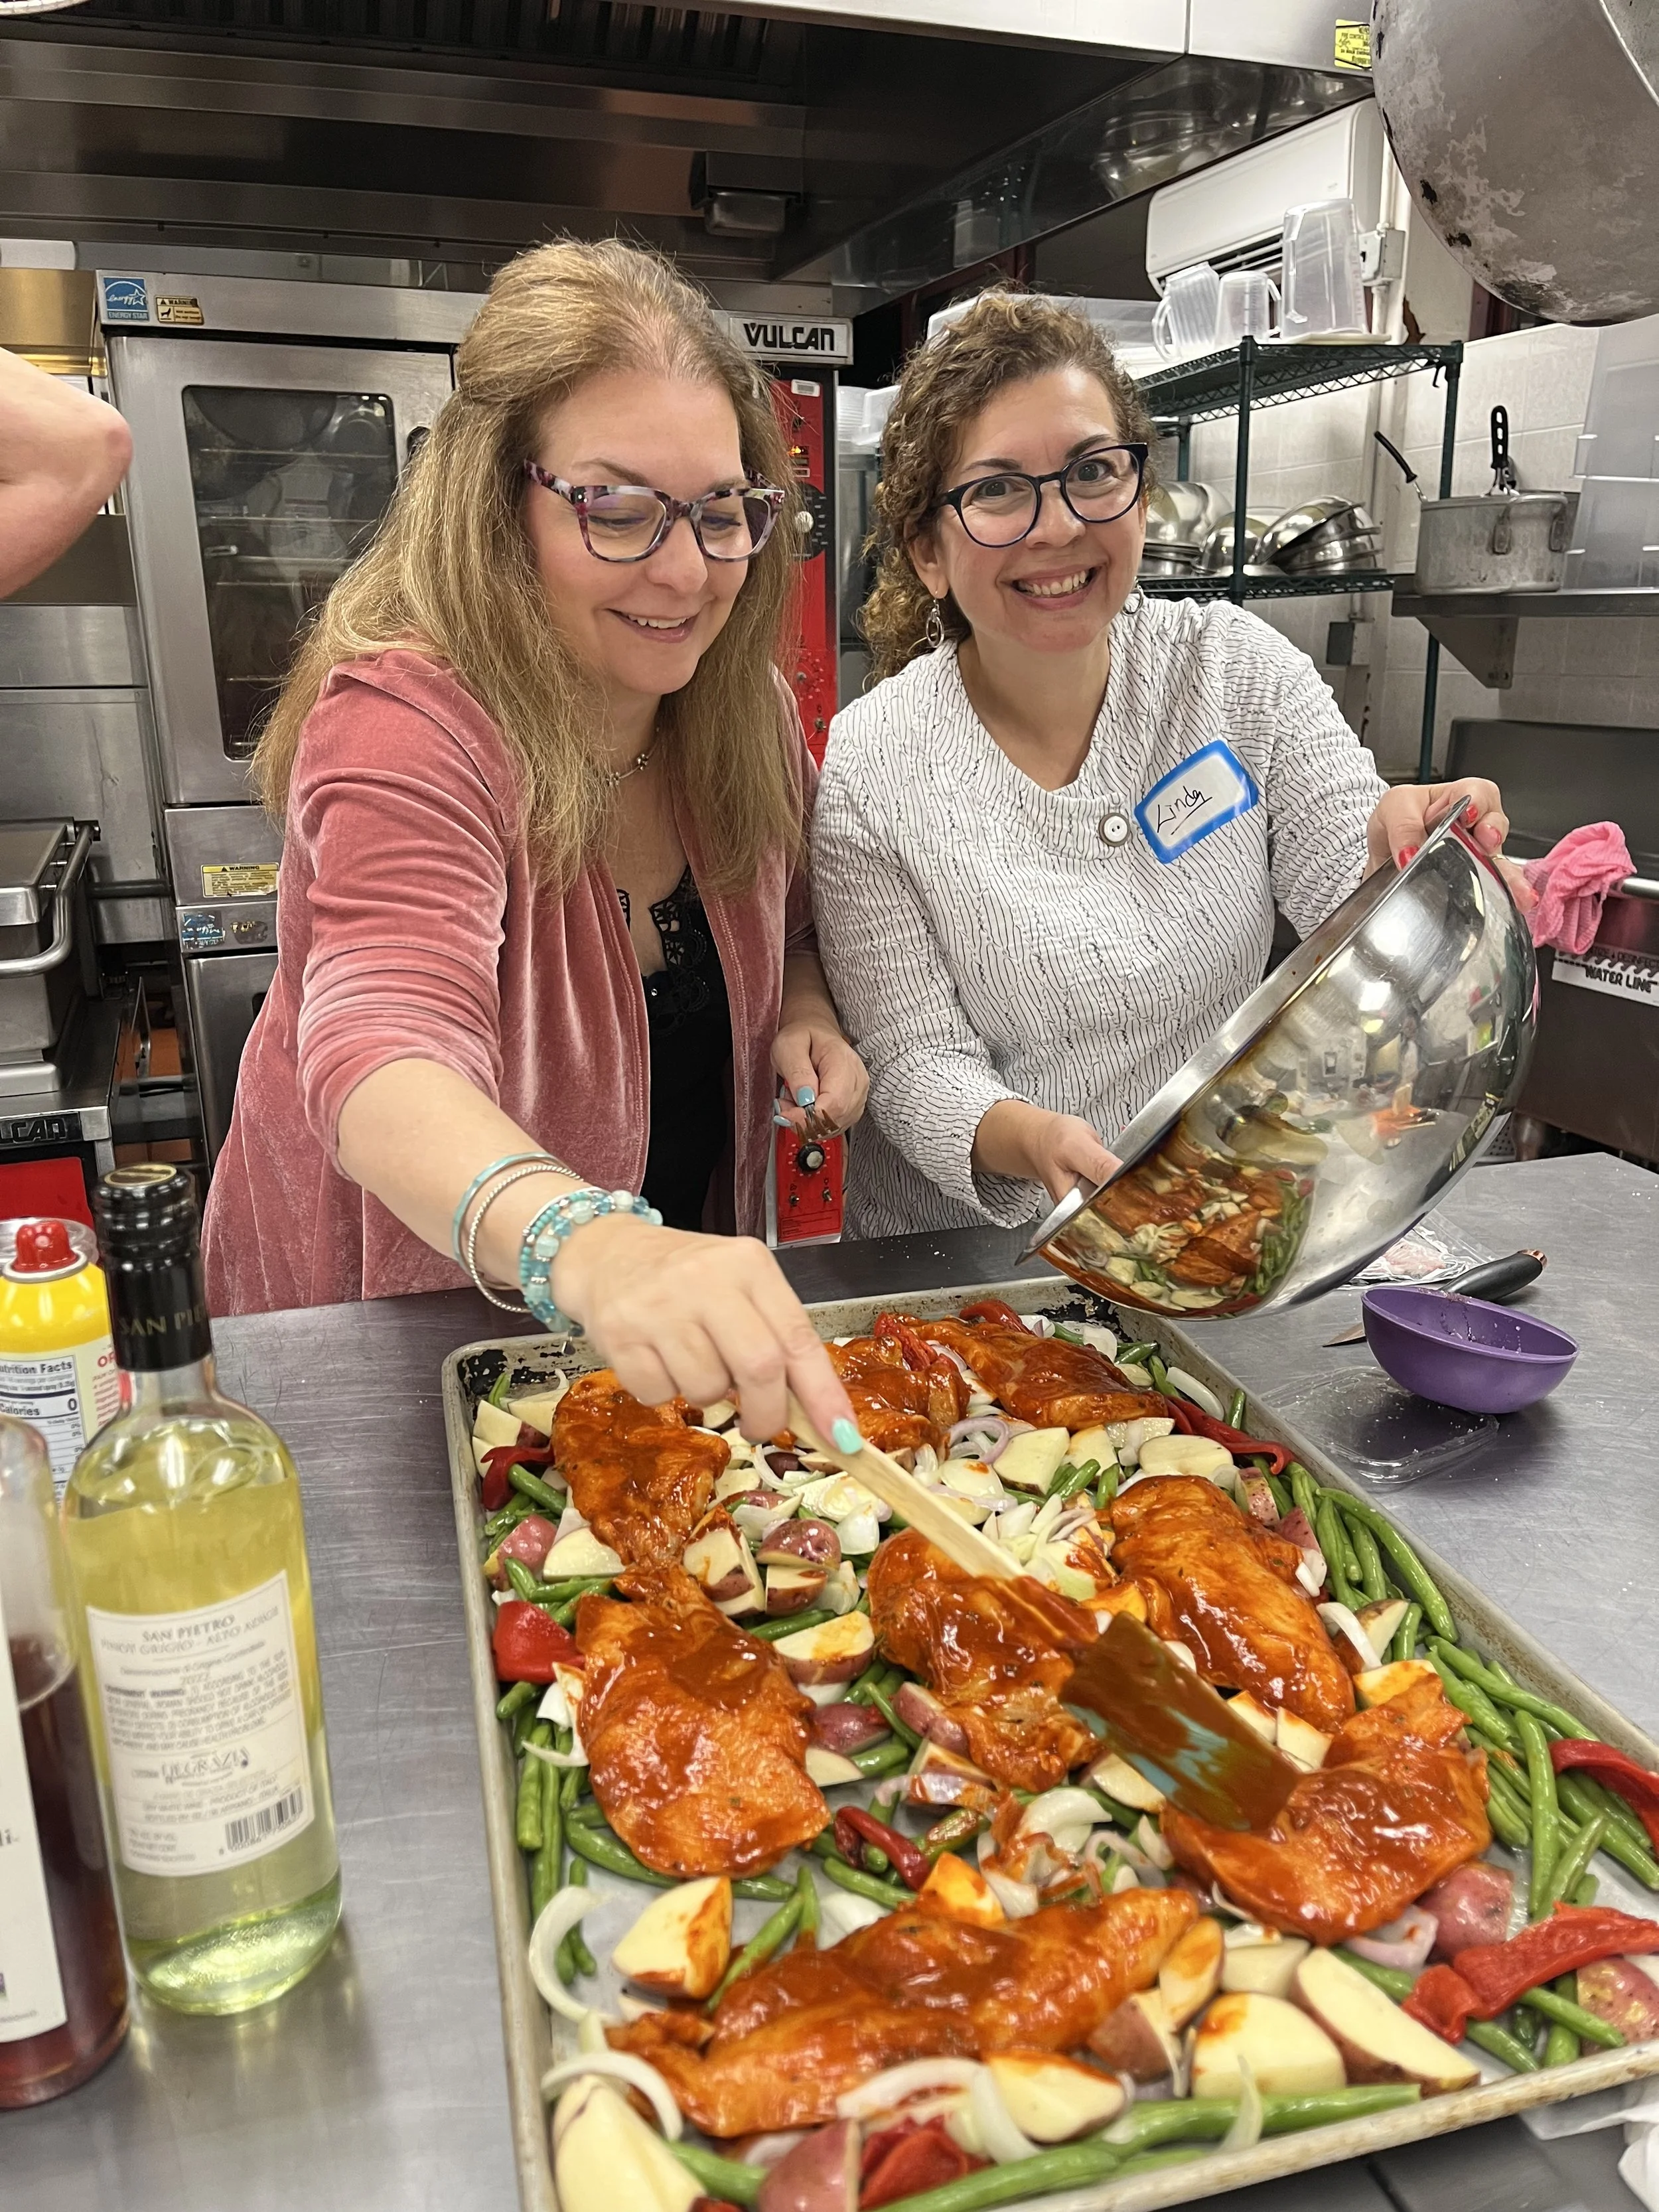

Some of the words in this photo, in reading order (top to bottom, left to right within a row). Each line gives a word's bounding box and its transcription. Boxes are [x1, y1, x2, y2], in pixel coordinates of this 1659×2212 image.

[743, 323, 835, 352] VULCAN
[1585, 965, 1623, 987] WATER
[1625, 974, 1652, 994] LINE
[40, 1361, 73, 1374] Facts
[0, 1402, 40, 1416] Calories
[67, 1398, 78, 1411] 0
[141, 1627, 173, 1643] SAN
[177, 1613, 236, 1639] PIETRO
